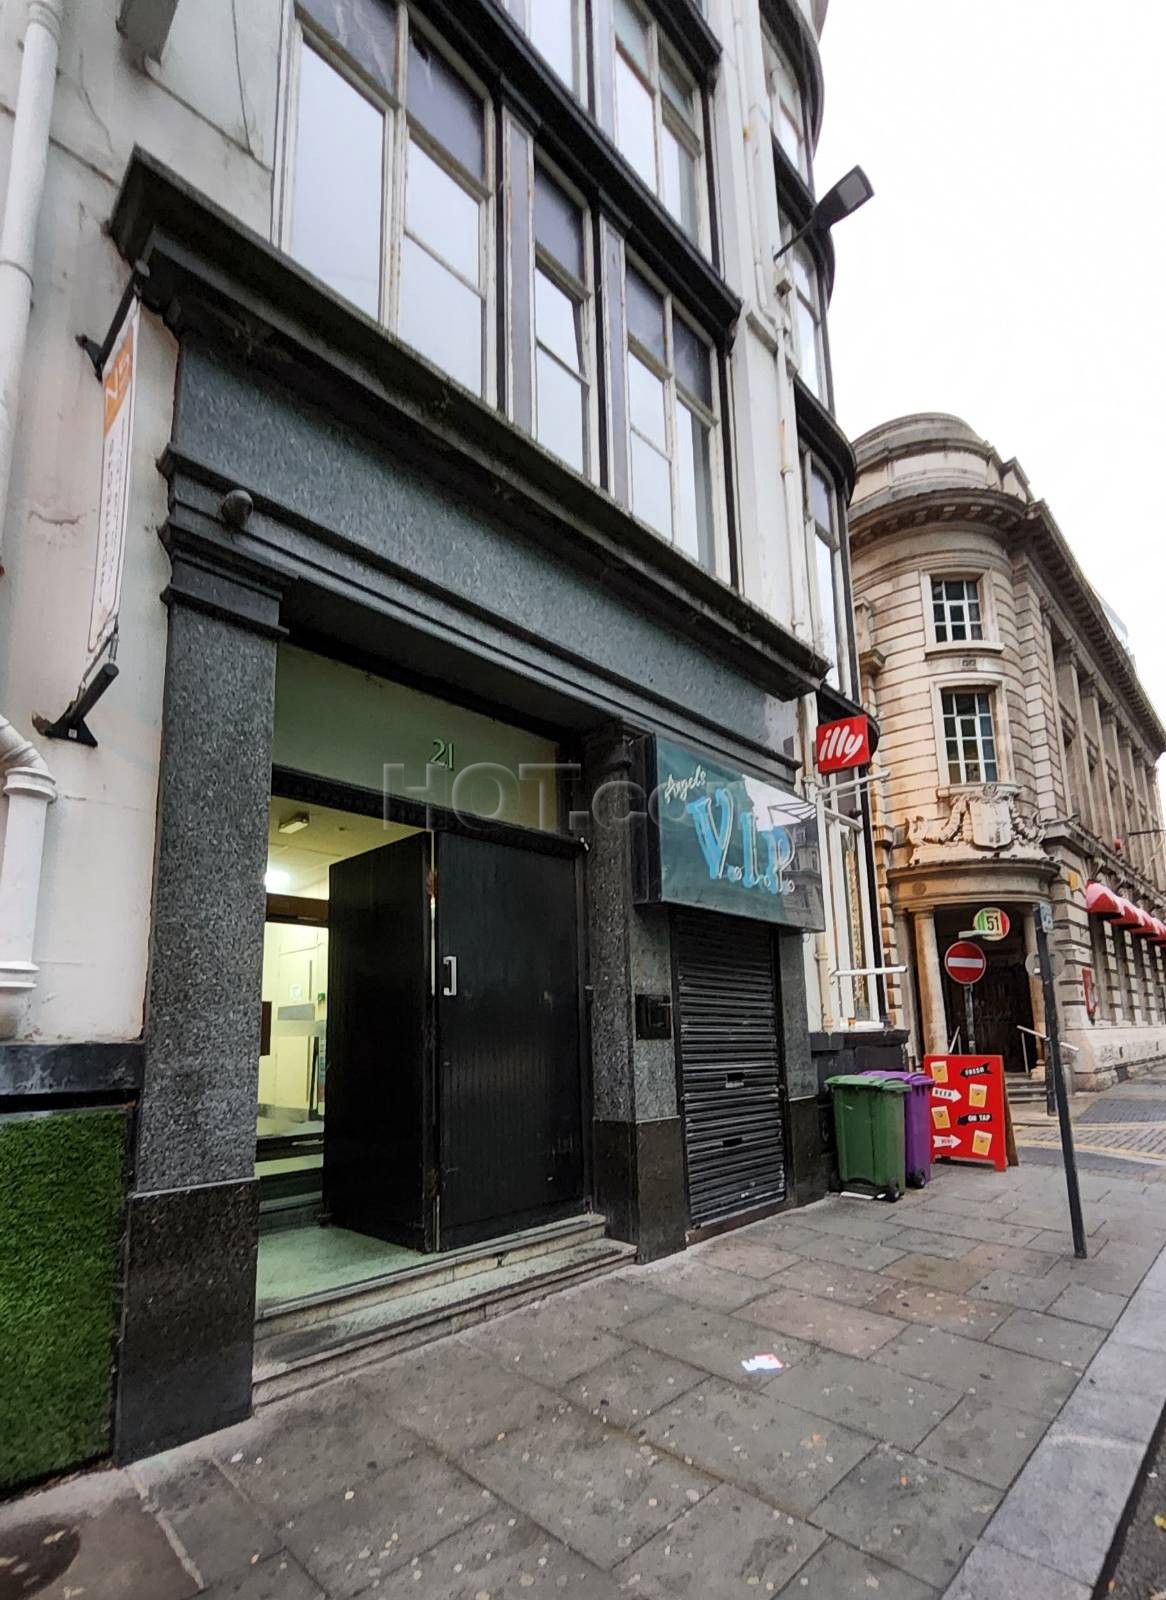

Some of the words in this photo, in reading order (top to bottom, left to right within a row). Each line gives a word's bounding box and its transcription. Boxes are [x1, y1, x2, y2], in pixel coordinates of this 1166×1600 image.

[430, 738, 455, 771] 21
[818, 724, 865, 765] illy
[664, 764, 708, 805] Angels
[986, 915, 1001, 931] 51
[978, 1114, 991, 1122] TAP
